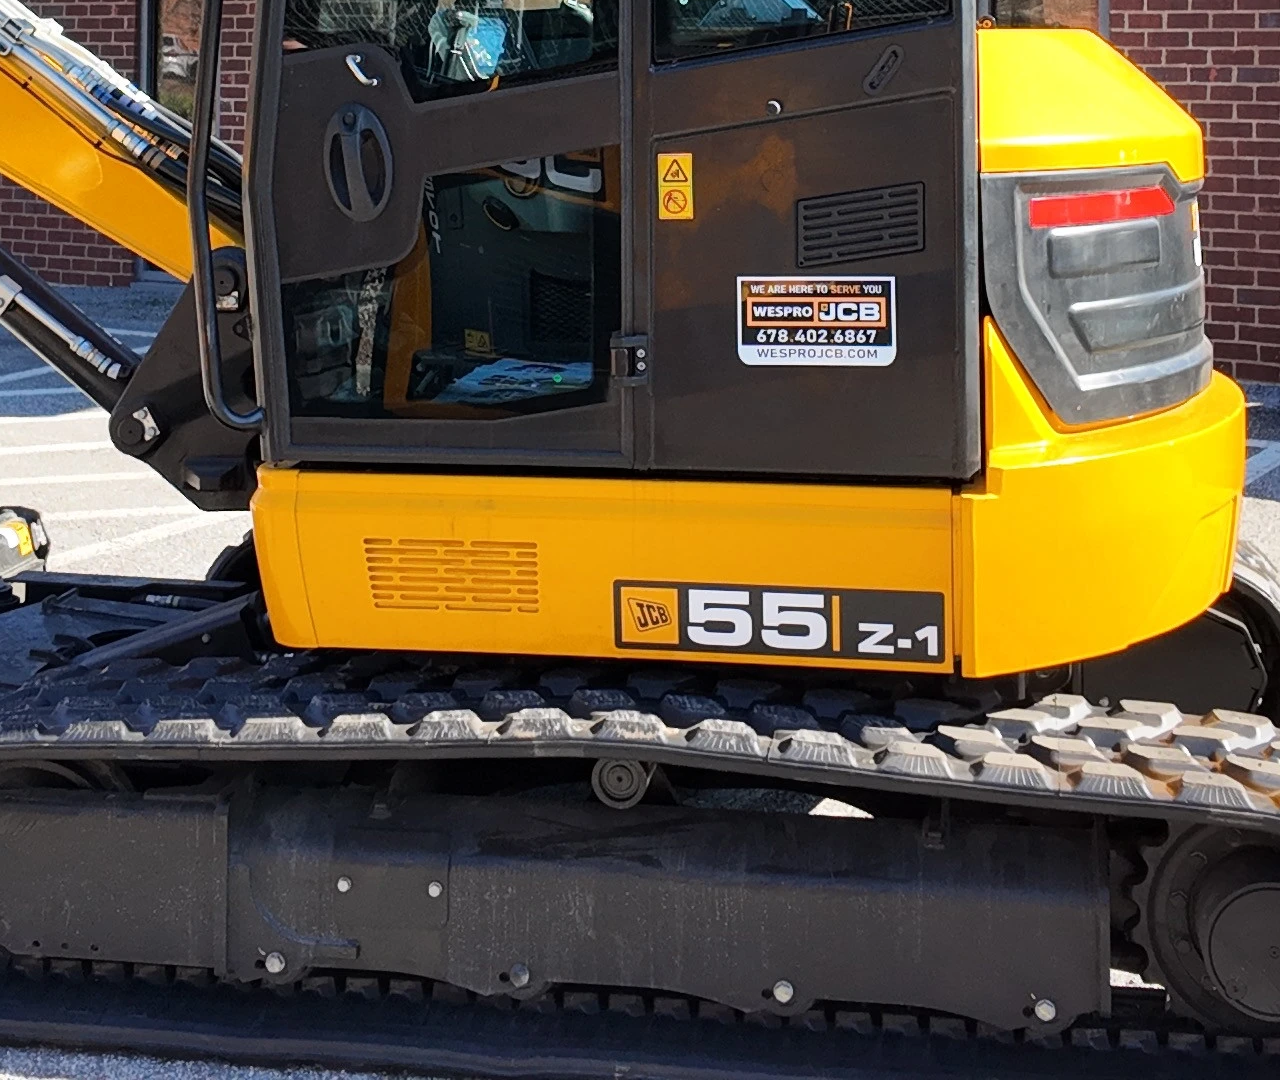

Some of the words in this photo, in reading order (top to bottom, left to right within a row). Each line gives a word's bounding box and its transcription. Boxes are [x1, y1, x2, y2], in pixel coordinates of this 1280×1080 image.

[750, 284, 765, 294] WE
[767, 284, 787, 294] ARE
[788, 284, 814, 294] HERE
[816, 284, 828, 294] TO
[830, 284, 862, 294] SERVE
[863, 284, 882, 294] YOU
[753, 306, 813, 318] WESPRO
[819, 302, 881, 322] JCB
[756, 328, 877, 344] 678.402.6867
[756, 348, 878, 359] WESPROJCB.COM
[636, 602, 669, 628] JCB
[687, 588, 827, 650] 55
[857, 622, 939, 656] Z-1
